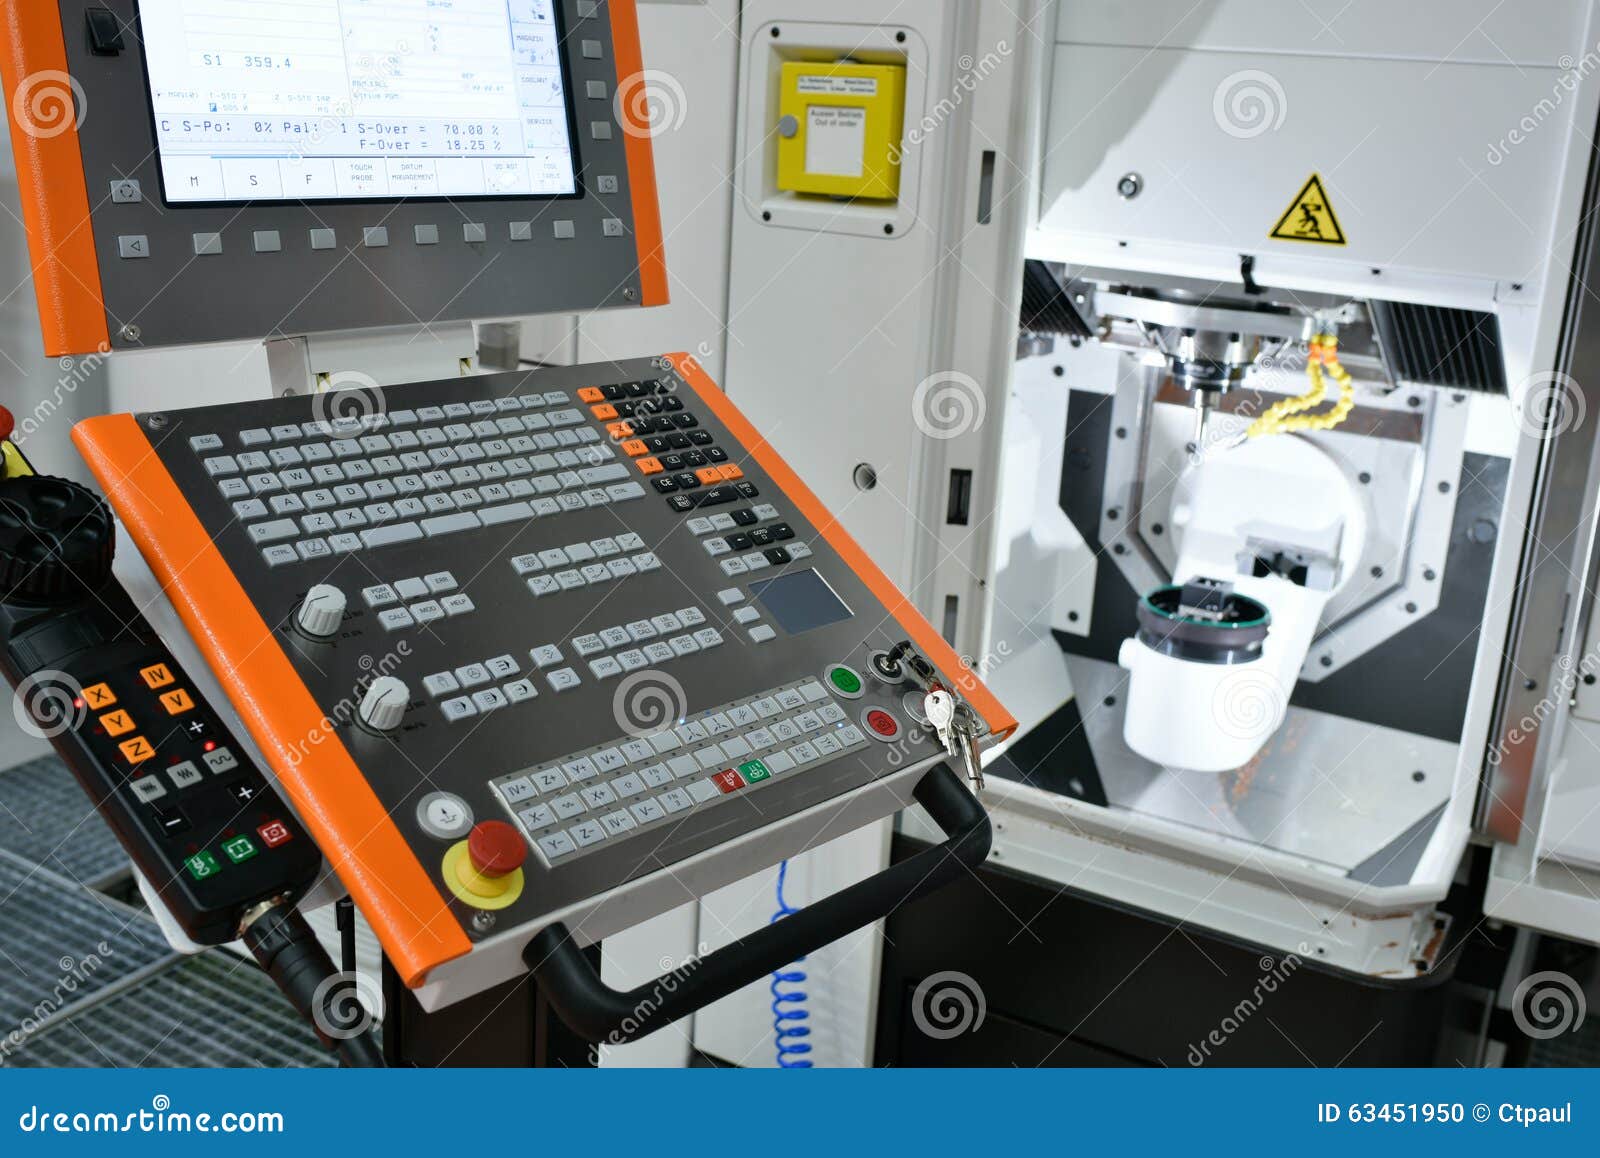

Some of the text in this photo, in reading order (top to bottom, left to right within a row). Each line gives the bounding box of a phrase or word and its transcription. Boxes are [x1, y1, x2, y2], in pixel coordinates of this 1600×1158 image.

[203, 54, 292, 68] S1 359.4
[162, 120, 347, 133] C S-Po: 0% Pal: 1
[358, 123, 408, 134] S-Over
[443, 124, 483, 135] 70.00
[492, 125, 500, 135] %
[360, 139, 410, 151] F-Over
[447, 140, 485, 151] 18.25
[494, 140, 501, 151] %
[190, 176, 199, 186] M
[250, 175, 258, 186] S
[306, 174, 313, 184] F
[324, 468, 333, 476] E
[354, 464, 363, 472] R
[260, 476, 271, 485] Q
[290, 472, 303, 480] W
[434, 474, 443, 482] H
[405, 478, 415, 486] G
[660, 479, 673, 487] CE
[346, 487, 355, 495] D
[490, 487, 501, 495] M
[315, 493, 325, 501] S
[462, 492, 472, 500] N
[284, 498, 294, 506] A
[377, 506, 386, 514] C
[346, 511, 356, 520] X
[314, 517, 324, 525] Z
[272, 549, 290, 557] CTRL
[435, 577, 448, 585] ERR
[450, 598, 466, 607] HELP
[420, 606, 436, 614] MOD
[598, 662, 613, 670] STOP
[150, 669, 165, 683] IV
[91, 689, 109, 703] X
[175, 696, 184, 707] V
[109, 715, 123, 728] Y
[128, 742, 147, 757] Z
[602, 754, 616, 765] V+
[572, 765, 586, 774] Y+
[542, 775, 556, 785] Z+
[508, 785, 527, 795] IV+
[593, 791, 605, 801] X+
[639, 807, 654, 816] V-
[529, 812, 545, 823] X-
[609, 818, 626, 829] IV-
[580, 828, 595, 839] Z-
[548, 839, 565, 849] Y-
